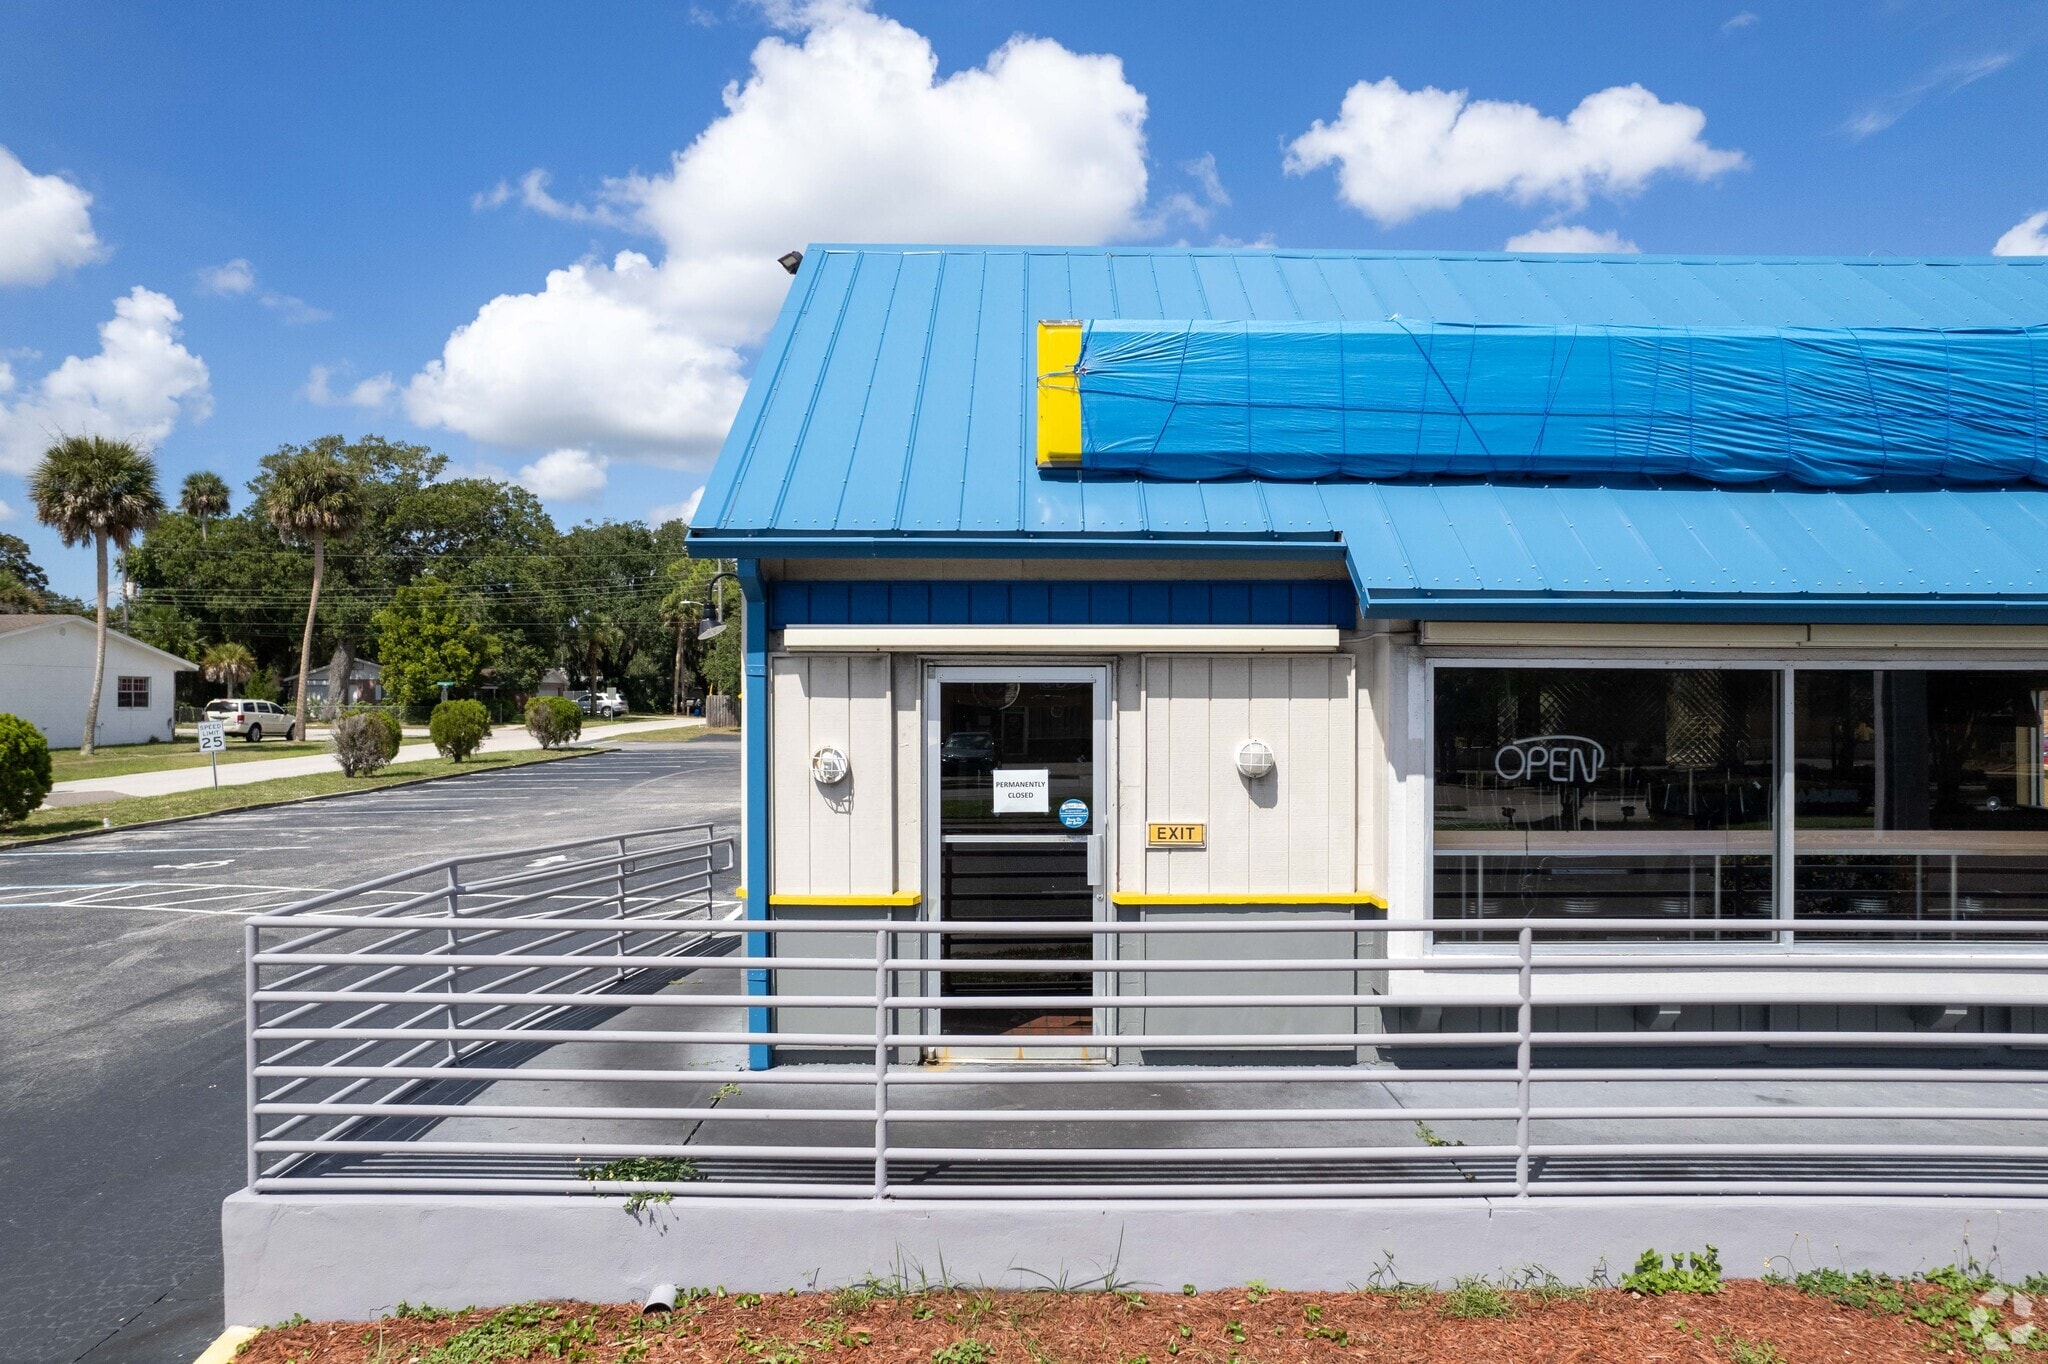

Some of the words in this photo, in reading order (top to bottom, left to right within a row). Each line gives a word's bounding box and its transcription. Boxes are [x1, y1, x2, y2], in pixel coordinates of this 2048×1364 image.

[202, 737, 223, 749] 25
[1495, 745, 1598, 783] OPEN
[1157, 827, 1195, 840] EXIT
